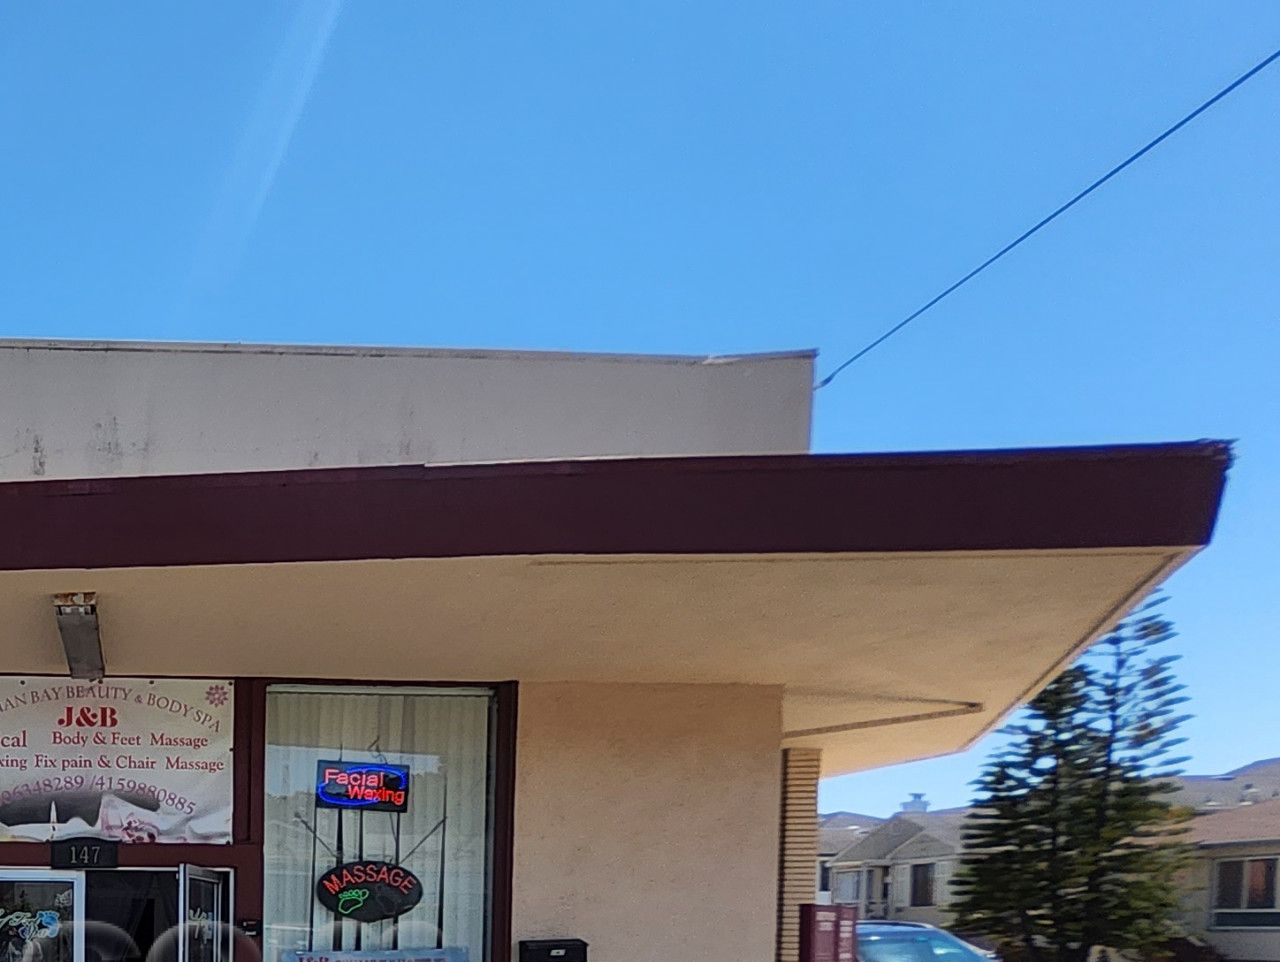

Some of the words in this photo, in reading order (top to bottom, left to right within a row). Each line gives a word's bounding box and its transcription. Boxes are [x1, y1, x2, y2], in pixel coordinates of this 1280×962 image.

[30, 687, 62, 704] BAY
[65, 685, 132, 701] BEAUTY
[134, 694, 144, 704] &
[147, 693, 193, 717] BODY
[193, 709, 220, 733] SPA
[57, 706, 118, 727] J&B
[52, 731, 88, 747] Body
[93, 731, 107, 745] &
[111, 732, 141, 746] Feet
[150, 732, 208, 749] Massage
[34, 754, 57, 768] Fix
[61, 755, 92, 771] pain
[97, 755, 111, 768] &
[115, 755, 157, 769] Chair
[165, 756, 224, 773] Massage
[324, 768, 384, 787] Facial
[347, 784, 405, 805] Waxing
[70, 846, 101, 864] 147
[323, 865, 417, 894] MASSAGE
